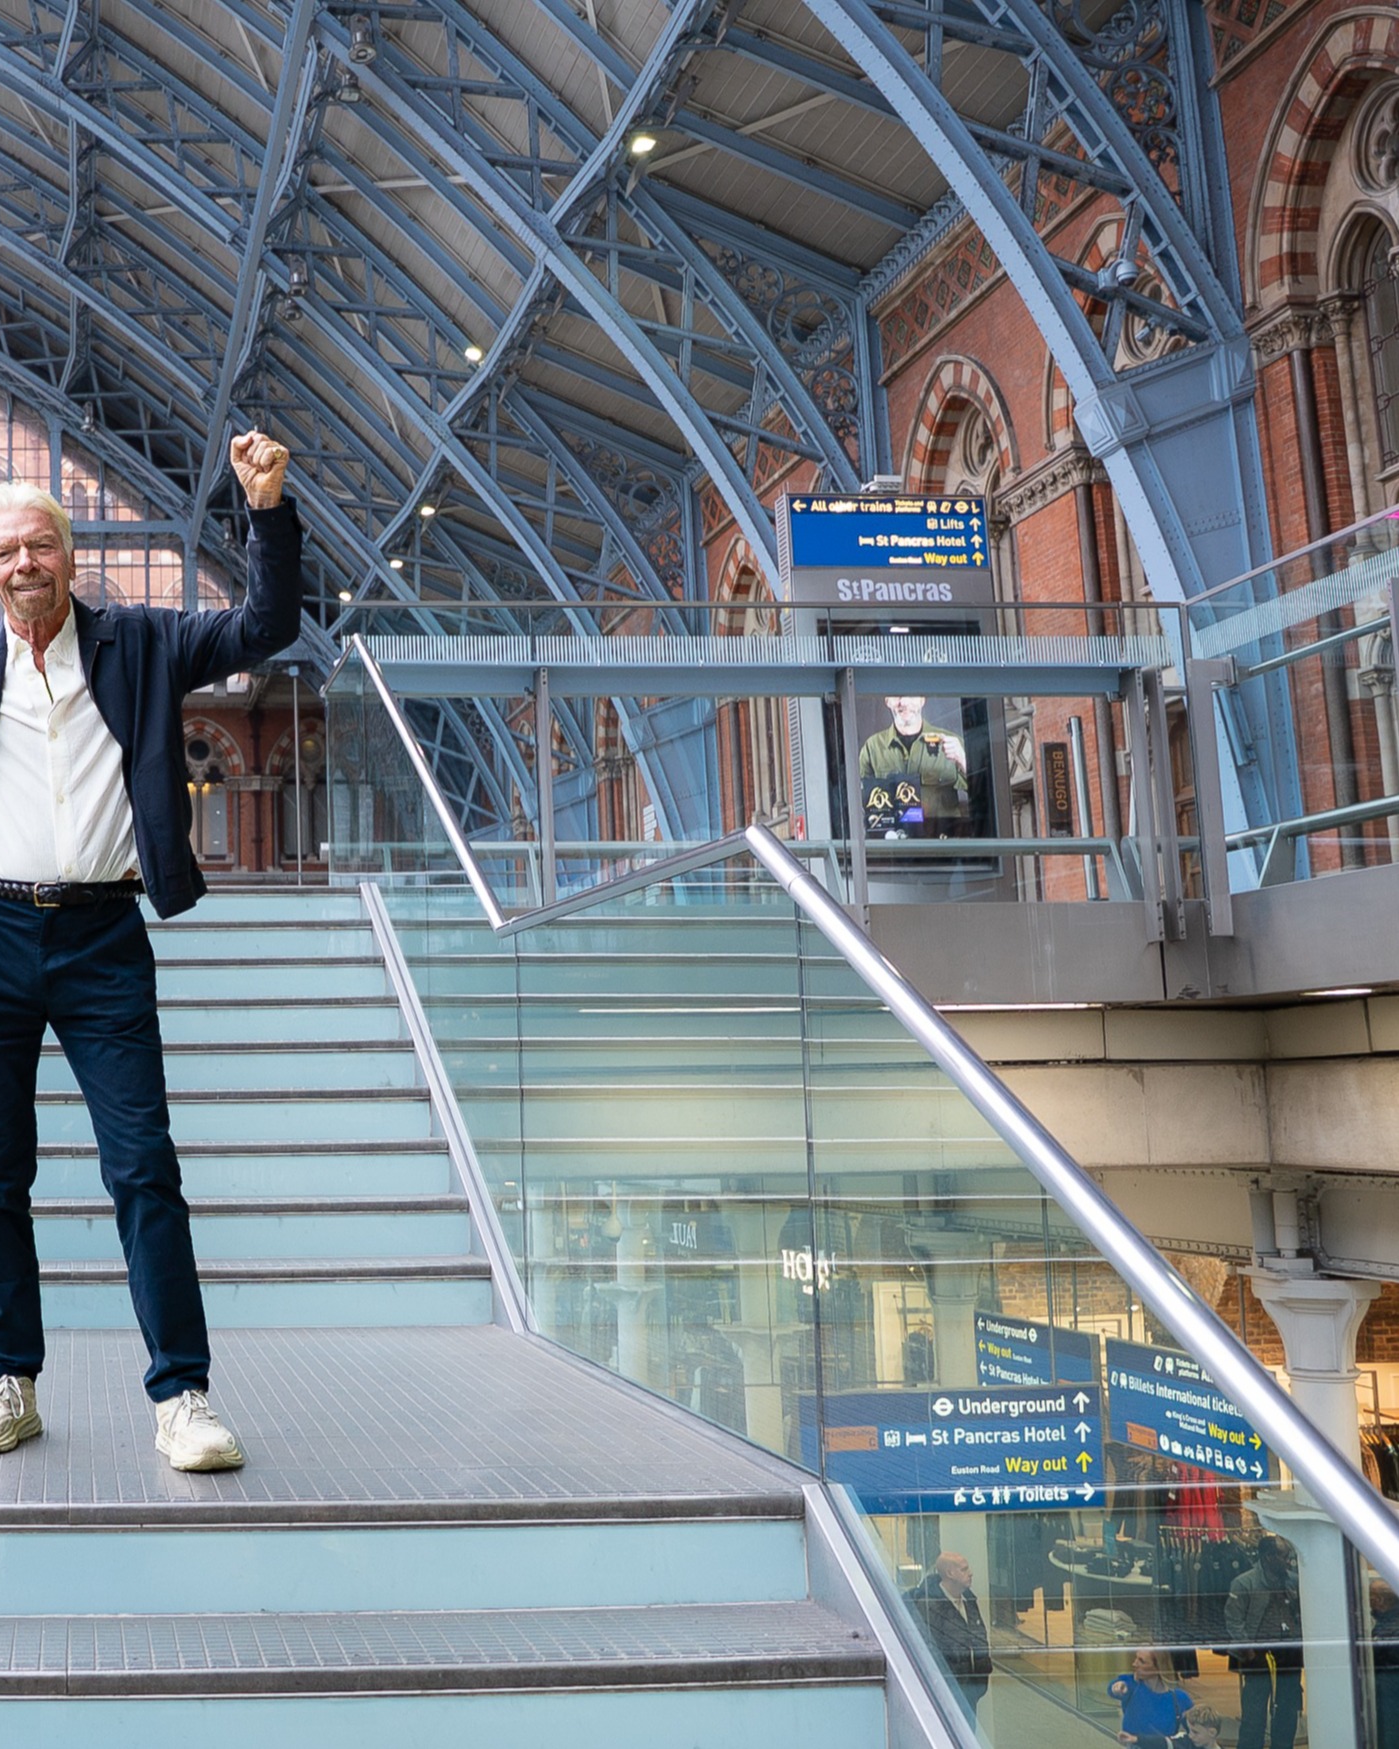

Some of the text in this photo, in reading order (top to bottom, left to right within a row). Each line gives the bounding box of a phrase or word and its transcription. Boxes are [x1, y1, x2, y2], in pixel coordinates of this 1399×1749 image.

[811, 500, 827, 512] All
[860, 501, 893, 513] trains
[940, 518, 965, 530] Lifts
[876, 535, 966, 547] St Pancras Hotel
[923, 552, 968, 566] Way out
[1052, 751, 1068, 811] BENUGO
[985, 1319, 1028, 1341] Underground
[986, 1341, 1012, 1359] Way out
[988, 1363, 996, 1377] St
[996, 1365, 1022, 1384] Pancras
[1128, 1376, 1155, 1396] Billets
[1156, 1382, 1211, 1410] International
[958, 1396, 1066, 1416] Underground
[931, 1425, 1067, 1445] St Pancras Hotel
[1207, 1422, 1245, 1446] Way out
[951, 1464, 1000, 1475] Euston Road
[1004, 1455, 1068, 1476] Way out
[1017, 1486, 1069, 1502] Toilets
